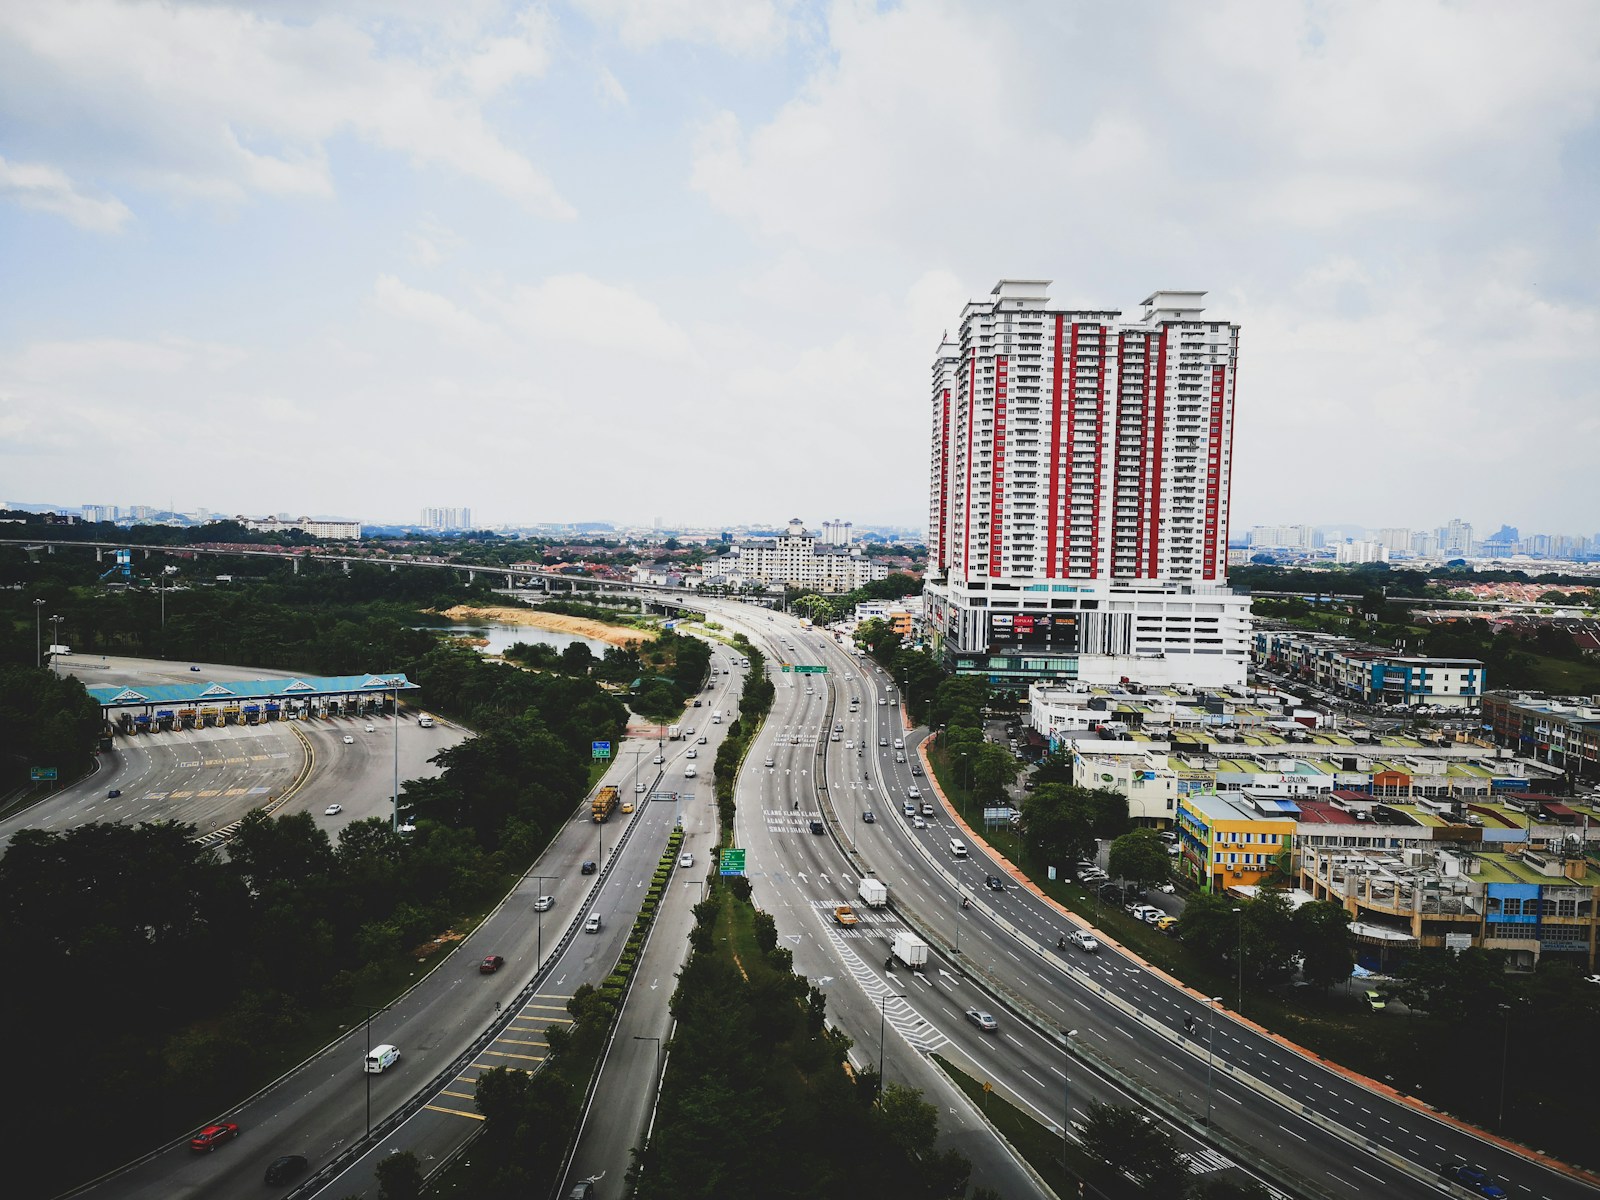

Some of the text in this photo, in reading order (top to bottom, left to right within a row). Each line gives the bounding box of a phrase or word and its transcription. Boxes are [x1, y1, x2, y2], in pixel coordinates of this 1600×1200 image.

[872, 914, 897, 922] ALAM
[836, 929, 862, 938] SHAH
[862, 928, 887, 938] SHAH
